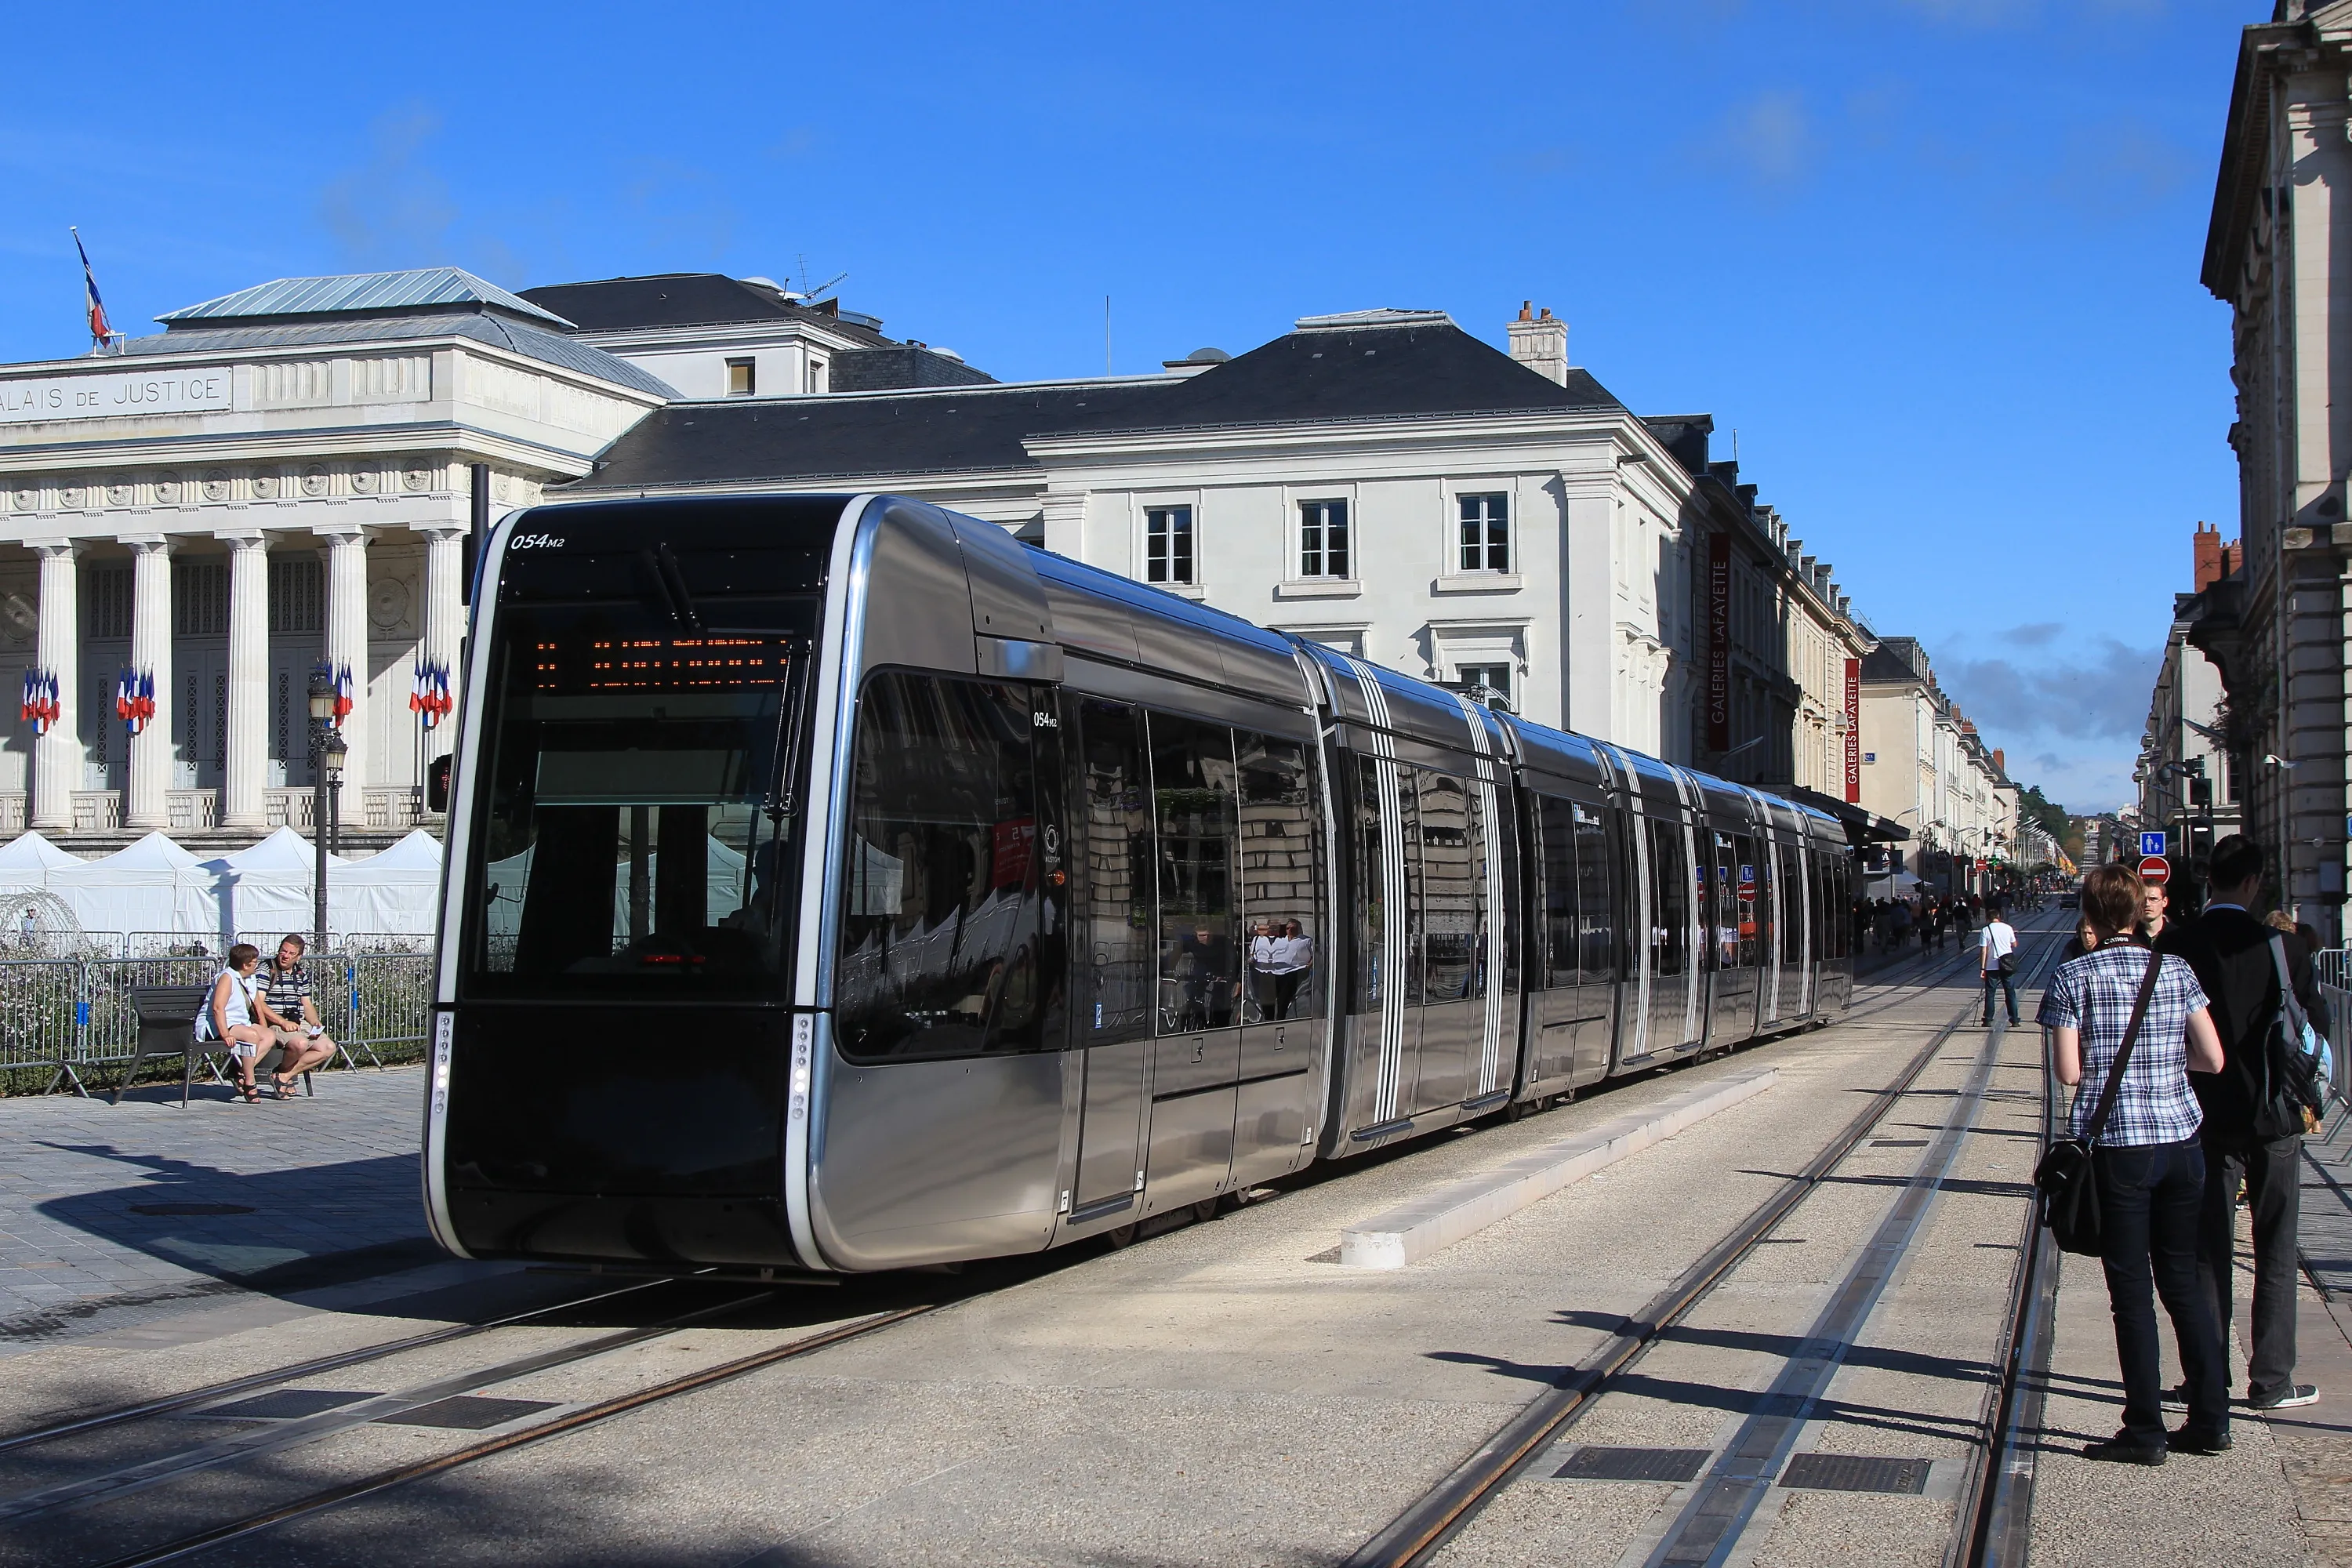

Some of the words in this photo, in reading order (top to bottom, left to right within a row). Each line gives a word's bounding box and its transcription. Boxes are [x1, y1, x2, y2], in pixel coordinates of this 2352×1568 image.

[76, 391, 100, 407] DE
[114, 378, 220, 404] JUSTICE
[1712, 561, 1726, 644] LAFAYETTE
[1711, 650, 1725, 724] GALERIES
[1847, 677, 1857, 731] LAFAYETTE
[1847, 735, 1857, 784] GALERIES
[2103, 936, 2129, 945] Canon
